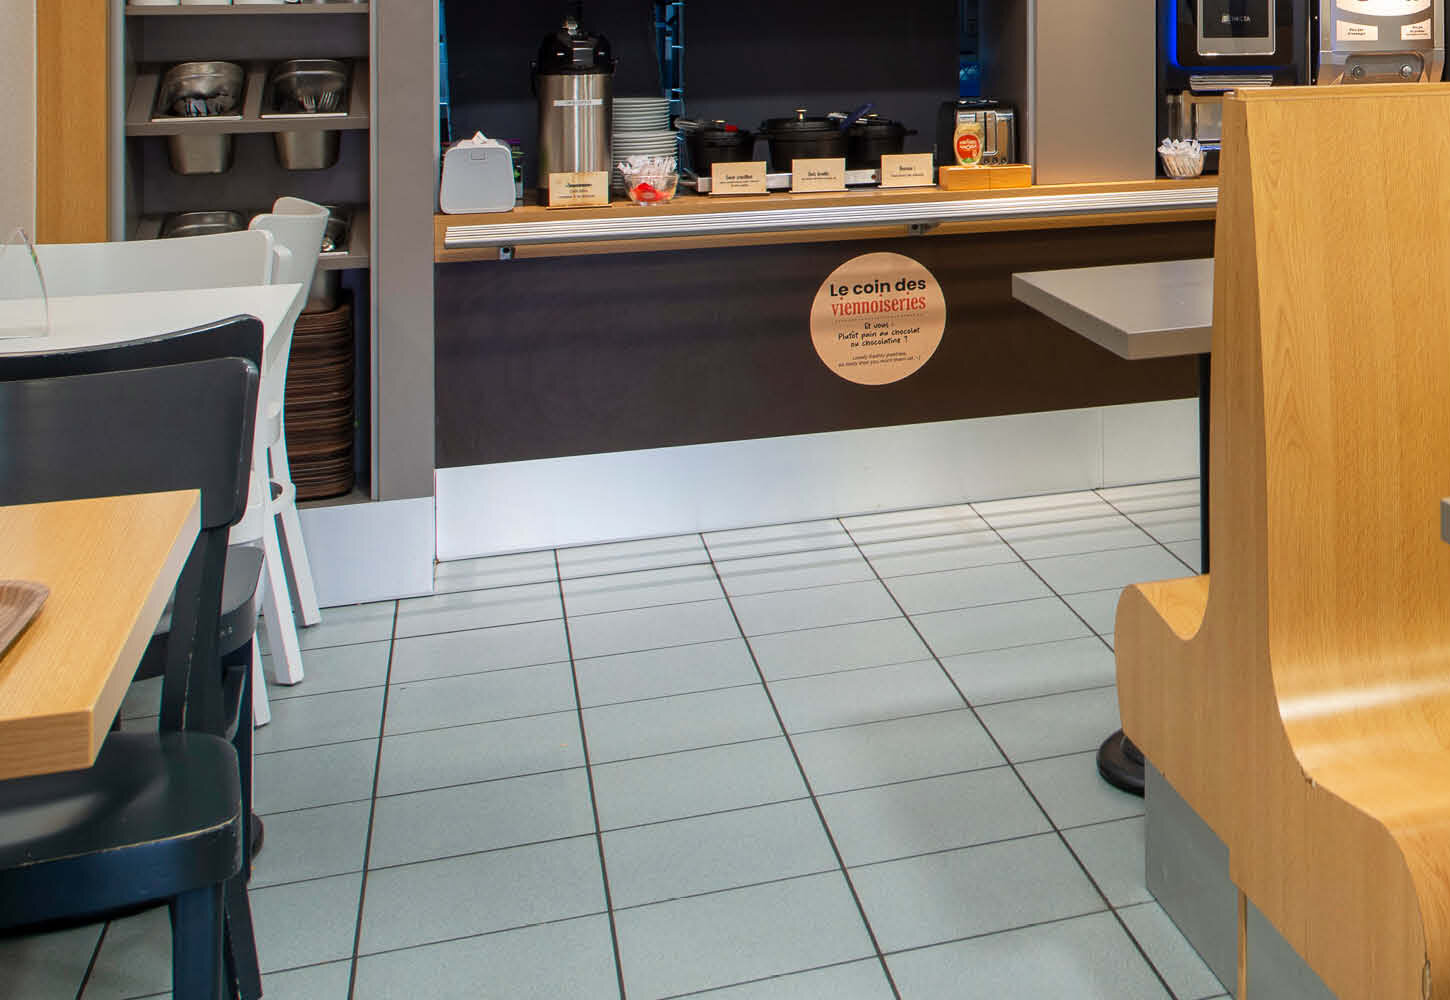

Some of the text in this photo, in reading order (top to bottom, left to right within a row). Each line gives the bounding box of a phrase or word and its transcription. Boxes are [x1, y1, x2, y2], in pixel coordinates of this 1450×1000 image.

[830, 278, 927, 297] Le coin des
[831, 293, 926, 317] viennoiseries
[891, 327, 920, 336] chocolat
[861, 337, 901, 347] chocolatine
